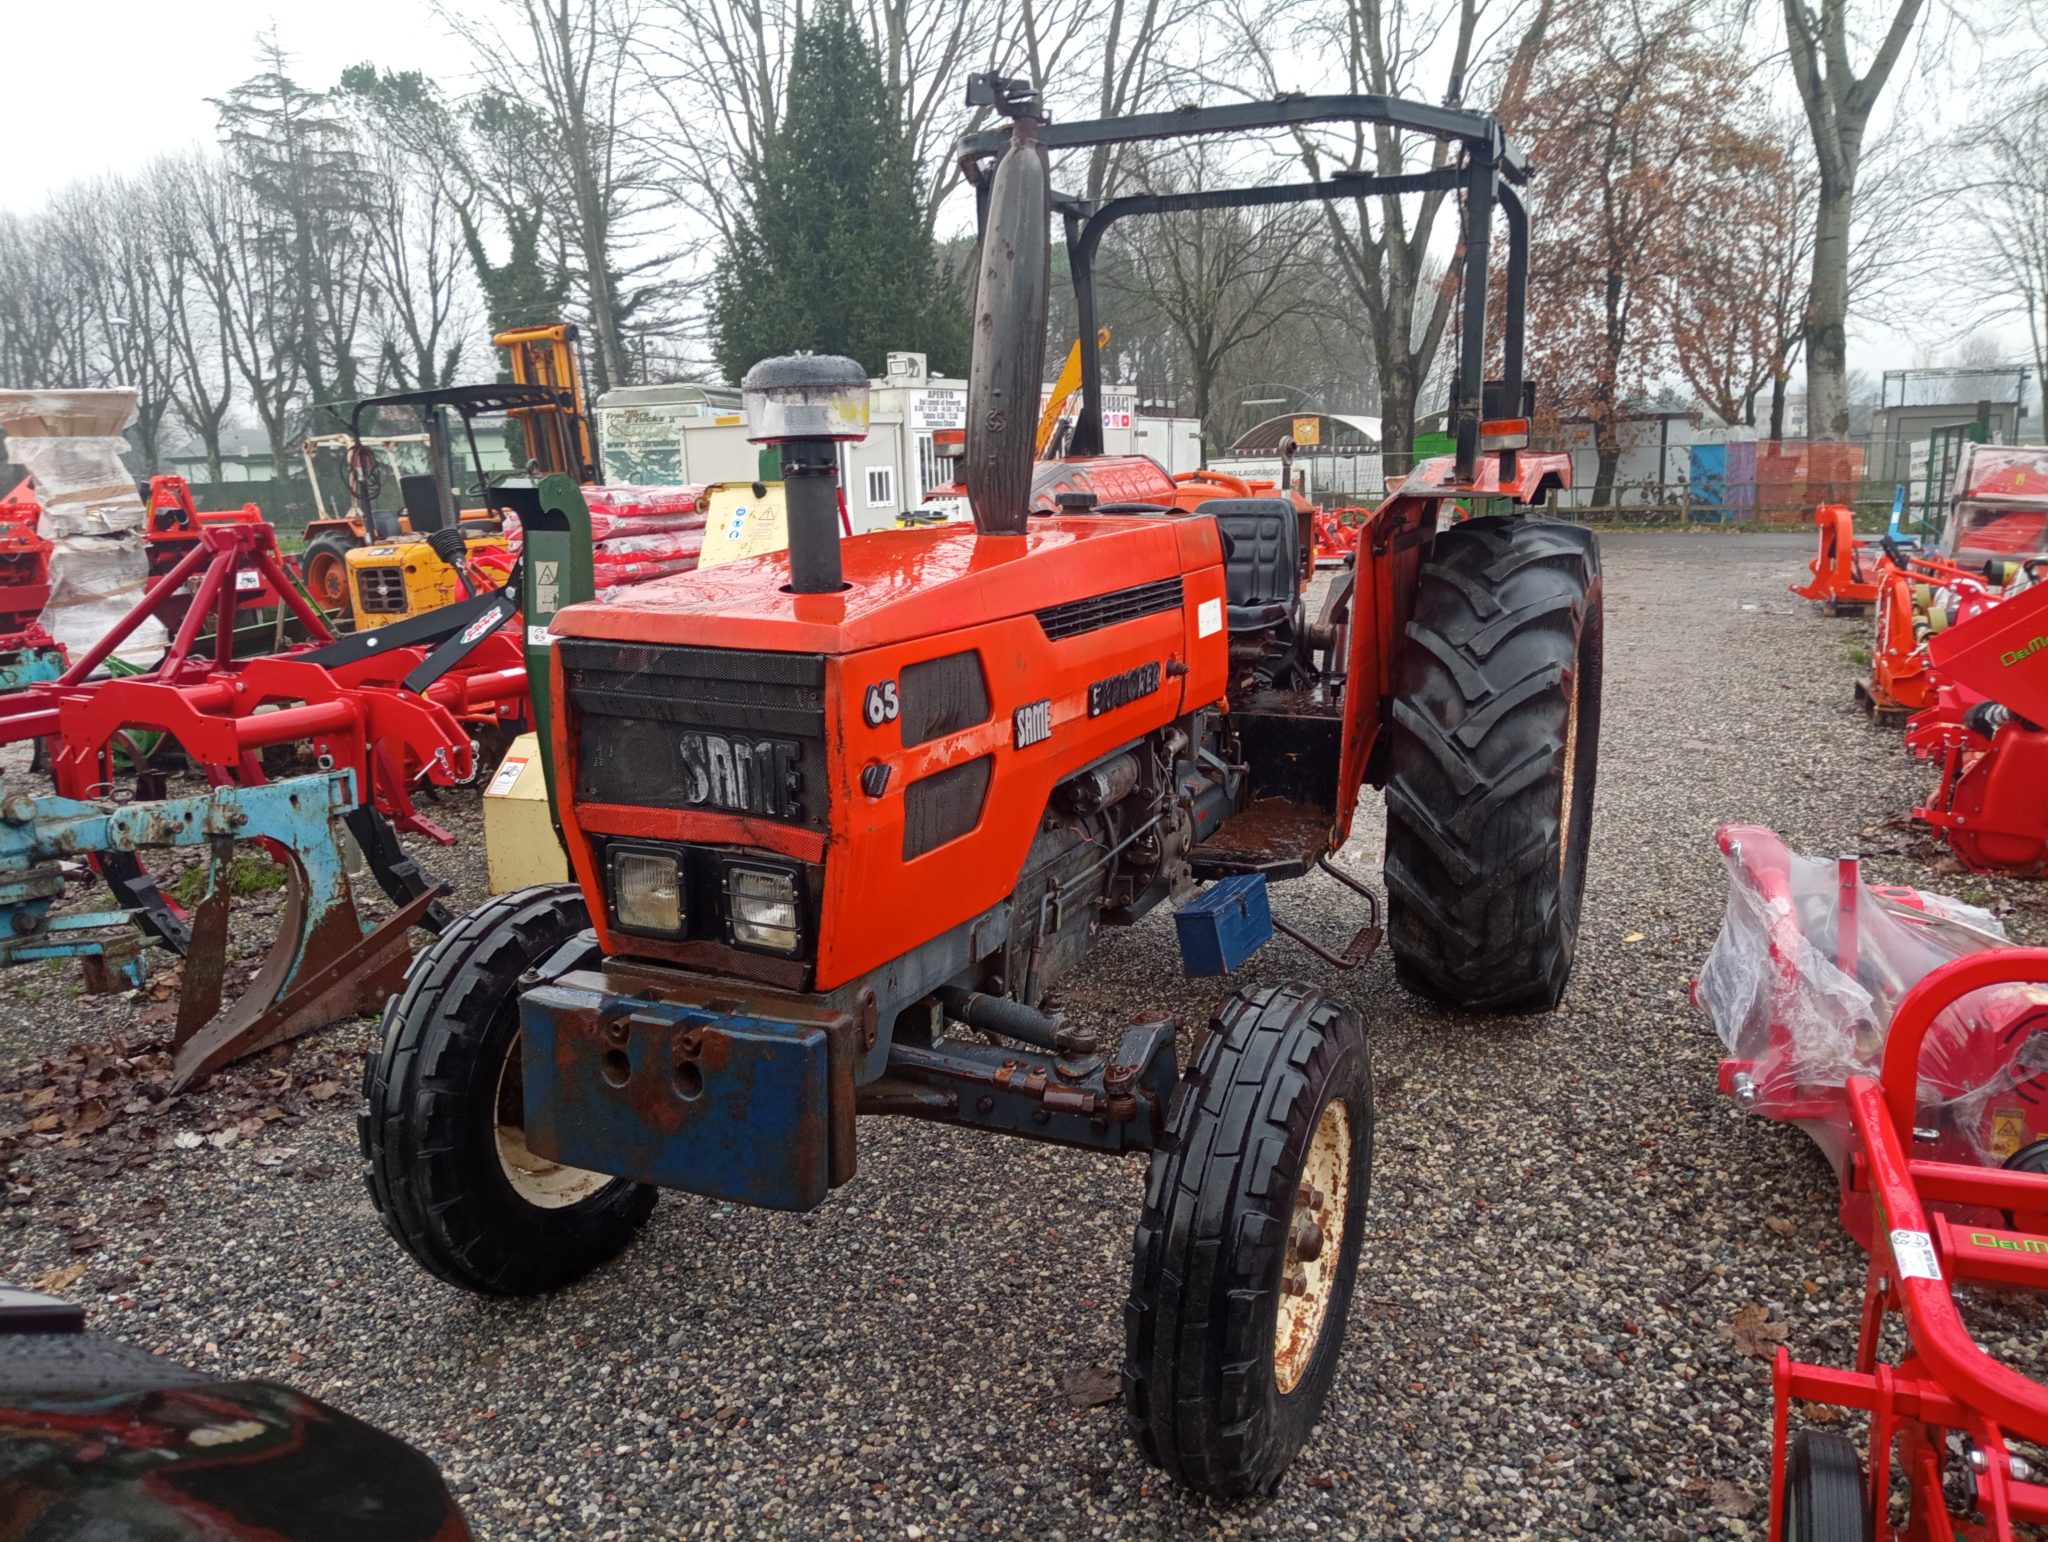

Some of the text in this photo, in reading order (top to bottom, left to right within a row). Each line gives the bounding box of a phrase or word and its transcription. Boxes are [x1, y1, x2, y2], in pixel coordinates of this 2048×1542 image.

[928, 391, 954, 399] APERTO
[869, 682, 899, 724] 65
[1016, 700, 1053, 748] SAME
[680, 736, 798, 818] SAME
